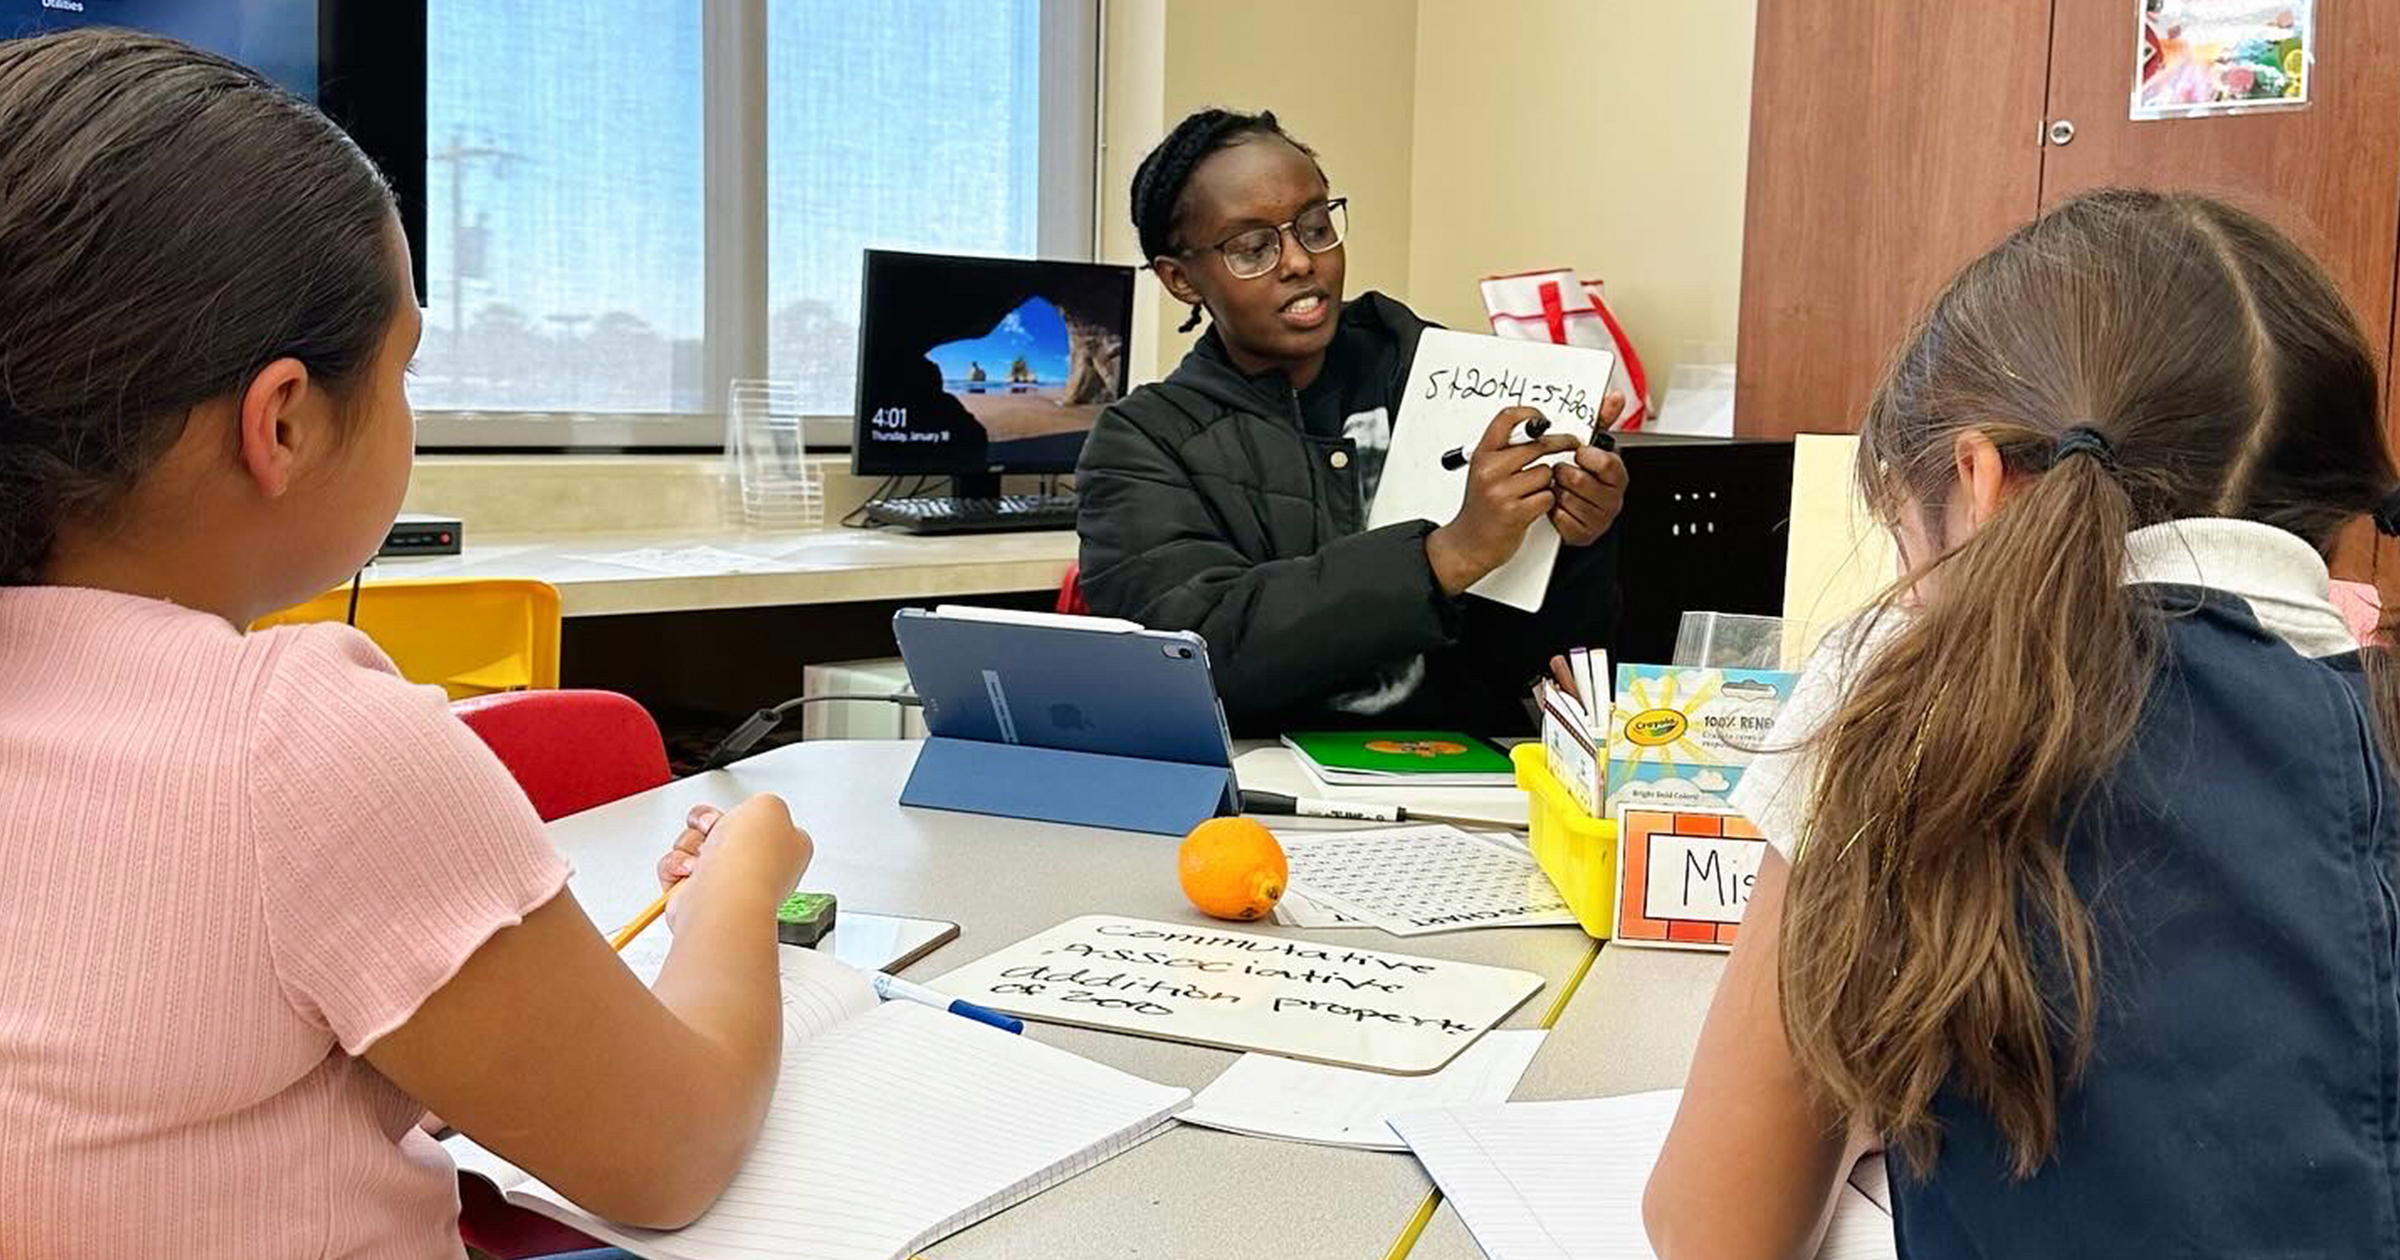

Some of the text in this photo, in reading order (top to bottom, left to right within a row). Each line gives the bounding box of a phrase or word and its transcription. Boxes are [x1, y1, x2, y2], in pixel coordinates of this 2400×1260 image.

[872, 407, 907, 428] 4:01
[1635, 718, 1675, 730] Crayola
[1704, 715, 1736, 728] 100%
